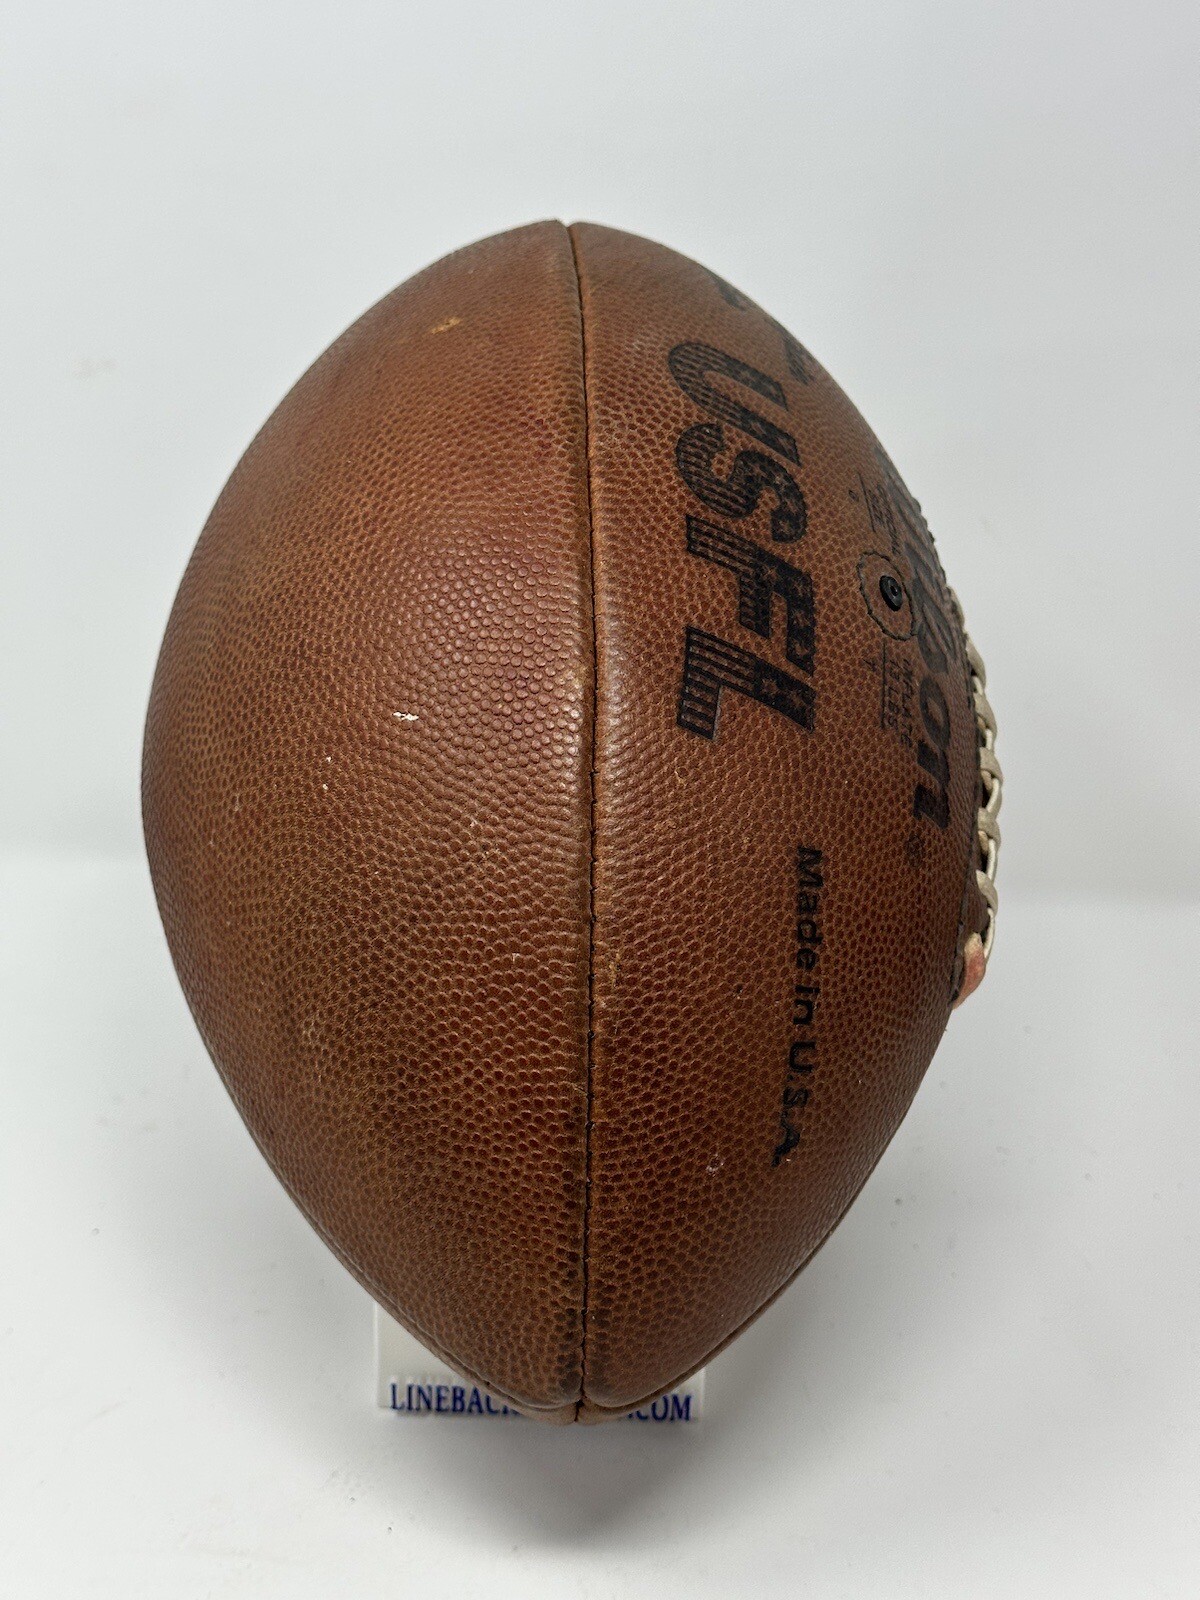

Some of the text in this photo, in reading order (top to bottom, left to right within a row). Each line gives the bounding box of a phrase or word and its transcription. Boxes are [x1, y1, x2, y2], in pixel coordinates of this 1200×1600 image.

[667, 341, 817, 741] USFL
[900, 658, 914, 748] INFLATE
[796, 846, 824, 970] Made
[792, 984, 820, 1026] in
